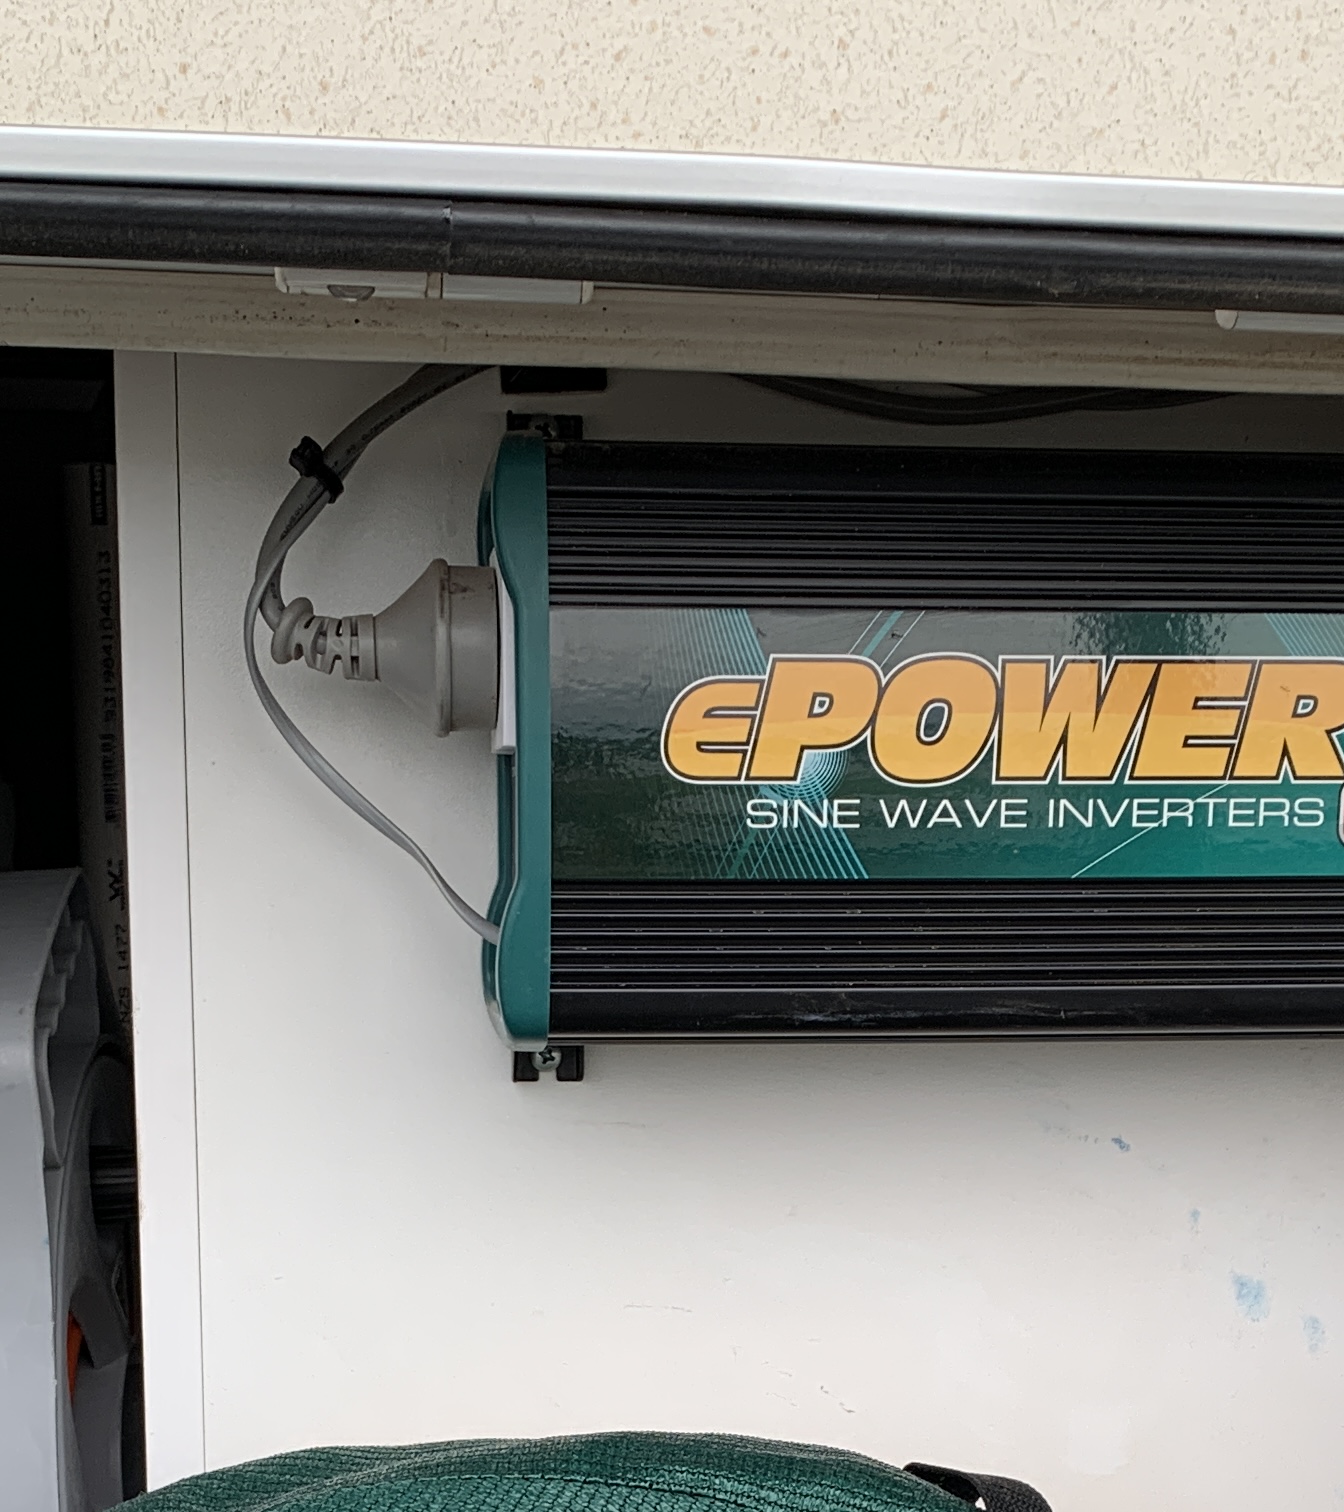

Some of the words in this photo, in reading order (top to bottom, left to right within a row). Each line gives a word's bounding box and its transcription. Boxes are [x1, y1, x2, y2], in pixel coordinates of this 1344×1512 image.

[745, 797, 861, 829] SINE
[879, 798, 1028, 829] WAVE
[1047, 797, 1325, 829] INVERTERS
